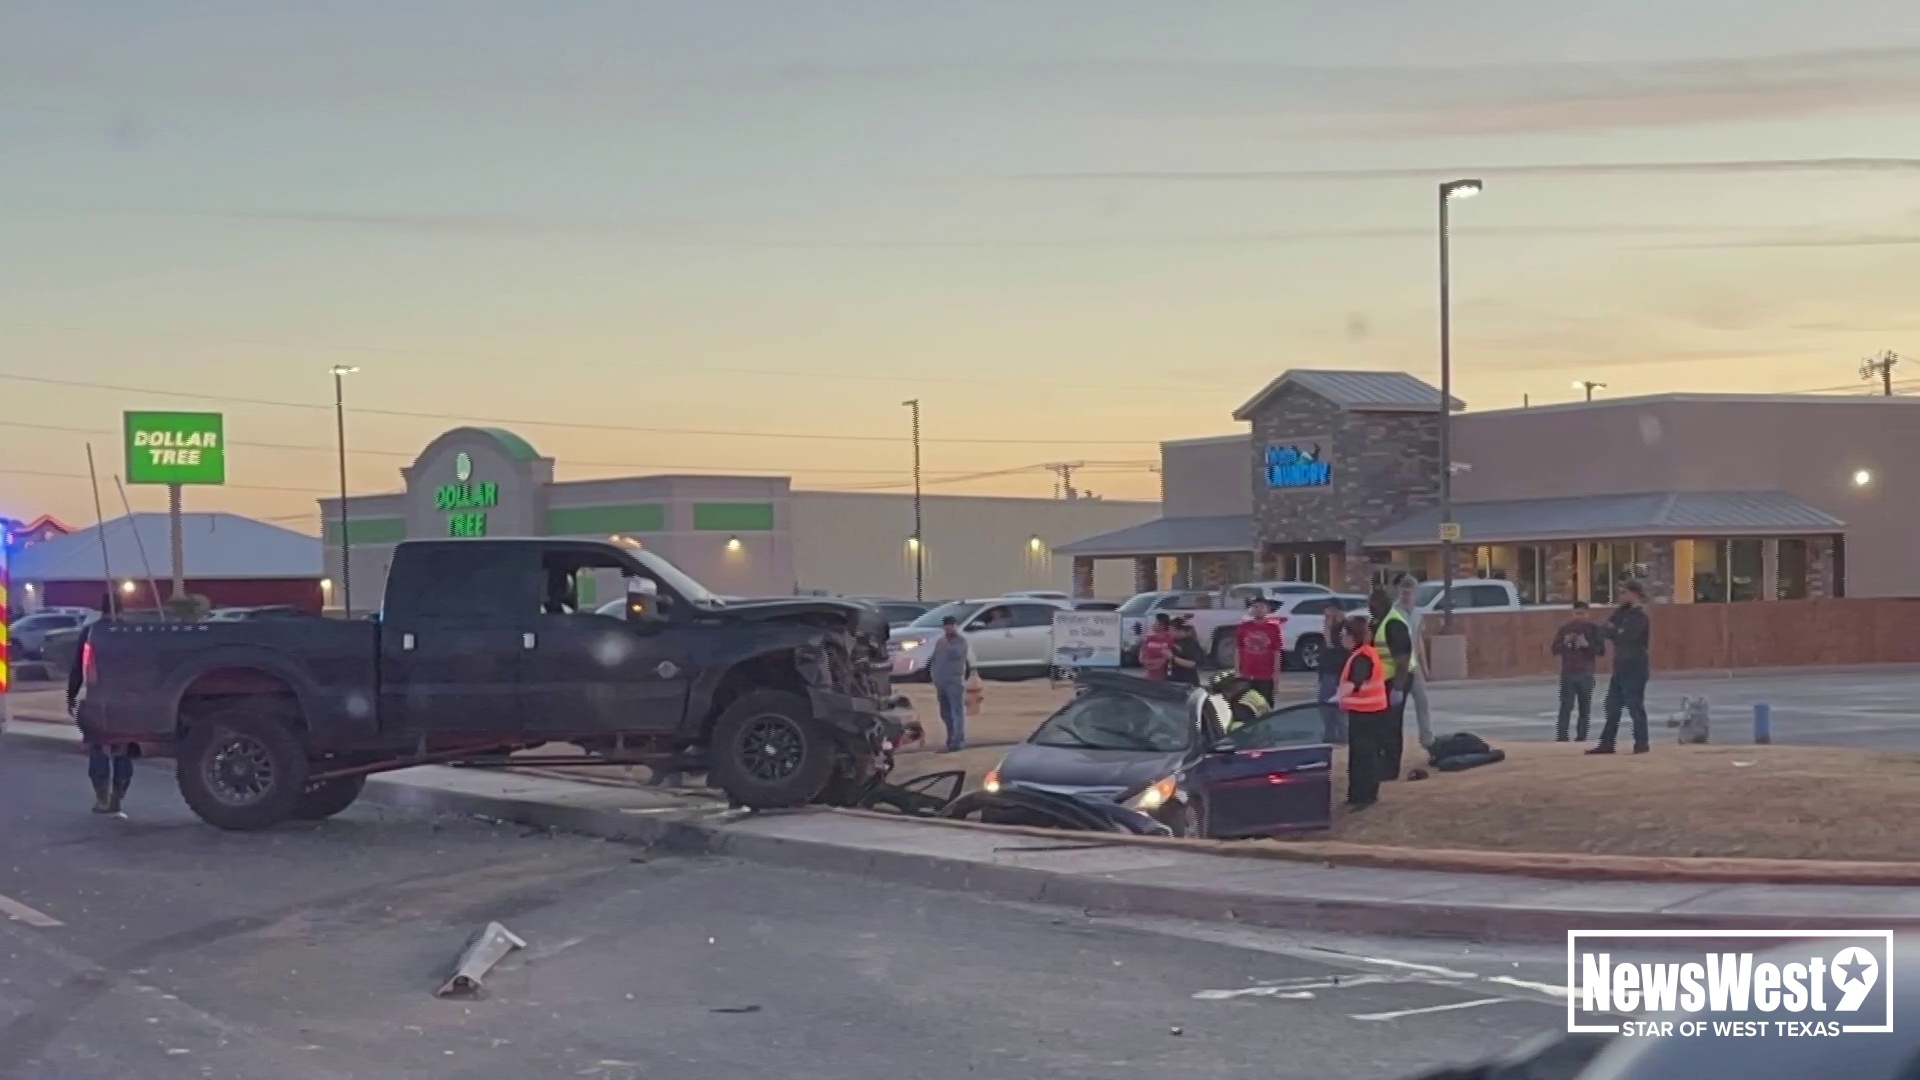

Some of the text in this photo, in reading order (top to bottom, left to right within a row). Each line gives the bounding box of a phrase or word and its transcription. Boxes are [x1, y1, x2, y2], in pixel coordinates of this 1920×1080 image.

[134, 430, 217, 447] DOLLAR
[149, 449, 201, 465] TREE
[435, 482, 497, 509] DOLLAR
[447, 513, 486, 537] TREE
